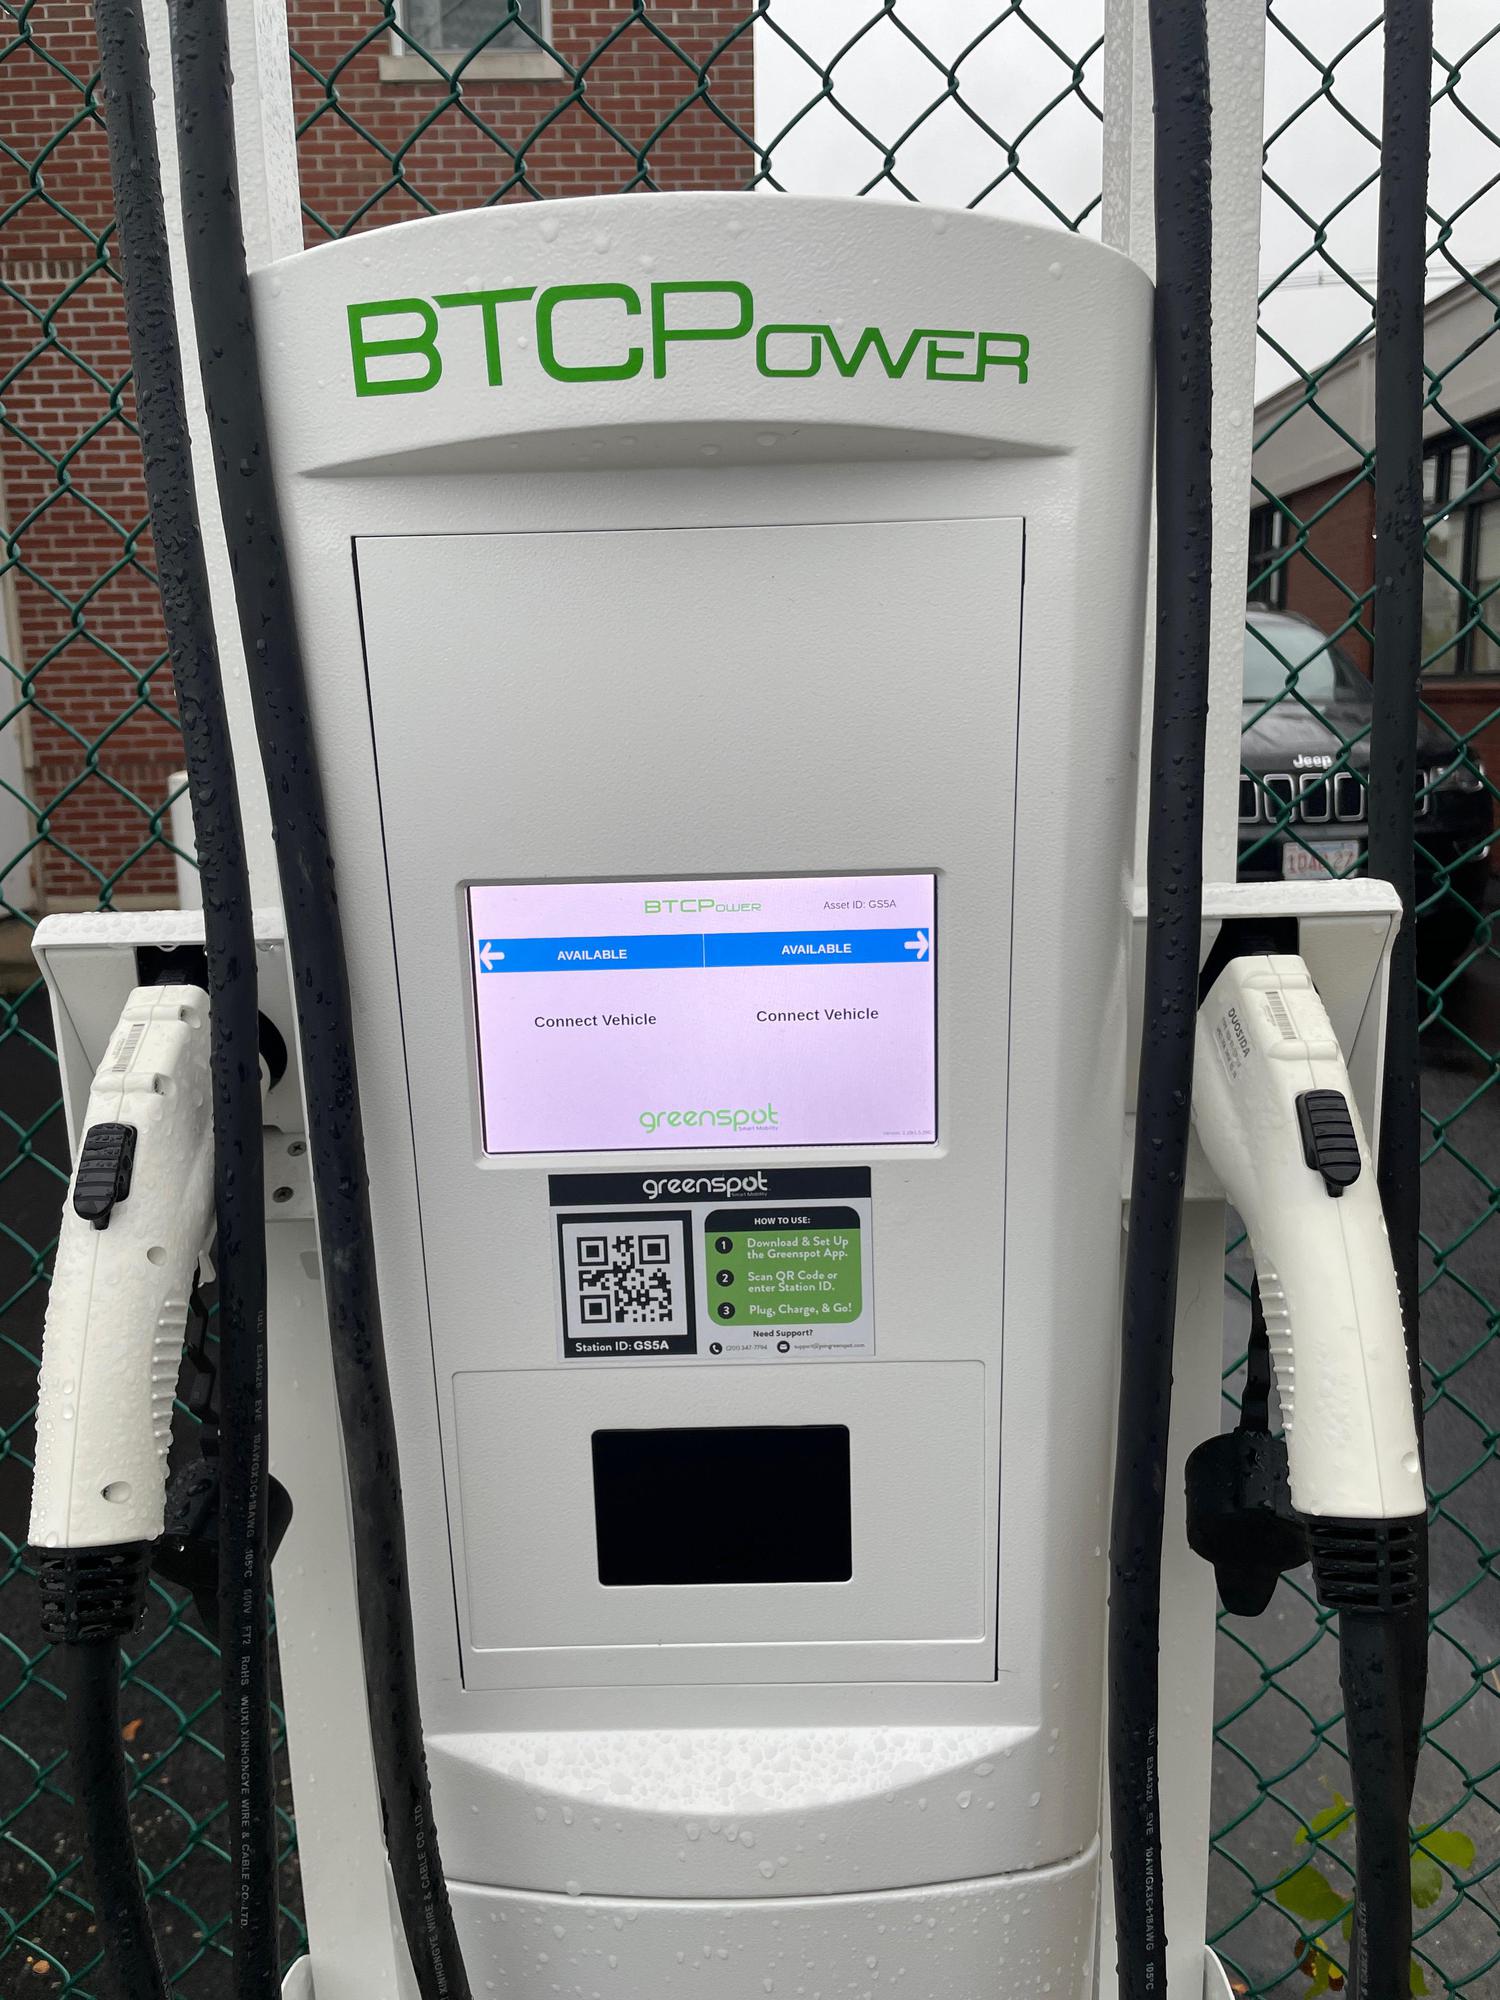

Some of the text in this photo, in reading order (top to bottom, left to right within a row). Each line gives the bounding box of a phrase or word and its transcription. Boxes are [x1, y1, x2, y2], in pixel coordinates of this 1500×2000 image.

[1293, 754, 1333, 769] Jeep
[823, 898, 897, 911] Asset ID: GS5A
[556, 948, 628, 961] AVAILABLE
[781, 942, 852, 955] AVAILABLE
[534, 1012, 657, 1028] Connect Vehicle
[755, 1006, 880, 1023] Connect Vehicle
[1228, 1007, 1250, 1058] DUOSIDA
[639, 1103, 779, 1134] greenspot
[642, 1171, 768, 1200] greenspot
[754, 1216, 811, 1226] HOW TO USE:
[747, 1237, 849, 1250] Download & Set Up
[747, 1248, 849, 1262] the Greenspot App.
[748, 1270, 838, 1284] Scan QR Code or
[748, 1281, 835, 1293] enter Station ID.
[749, 1302, 852, 1318] Plug, Charge, & Go!
[776, 1329, 813, 1338] Support?
[575, 1340, 669, 1353] Station ID: GS5A
[254, 1399, 262, 1422] EVE
[241, 1625, 252, 1645] FT2
[240, 1655, 250, 1686] RoHS
[240, 1696, 249, 1726] WUXI
[240, 1729, 250, 1795] XINHONGYE
[241, 1798, 250, 1827] WIRE
[241, 1831, 250, 1839] &
[240, 1843, 250, 1880] CABLE
[417, 1851, 431, 1889] CABLE
[423, 1891, 432, 1900] &
[425, 1903, 437, 1933] WIRE
[429, 1934, 448, 1994] XINHONGYE
[1145, 1961, 1154, 1990] 105°C
